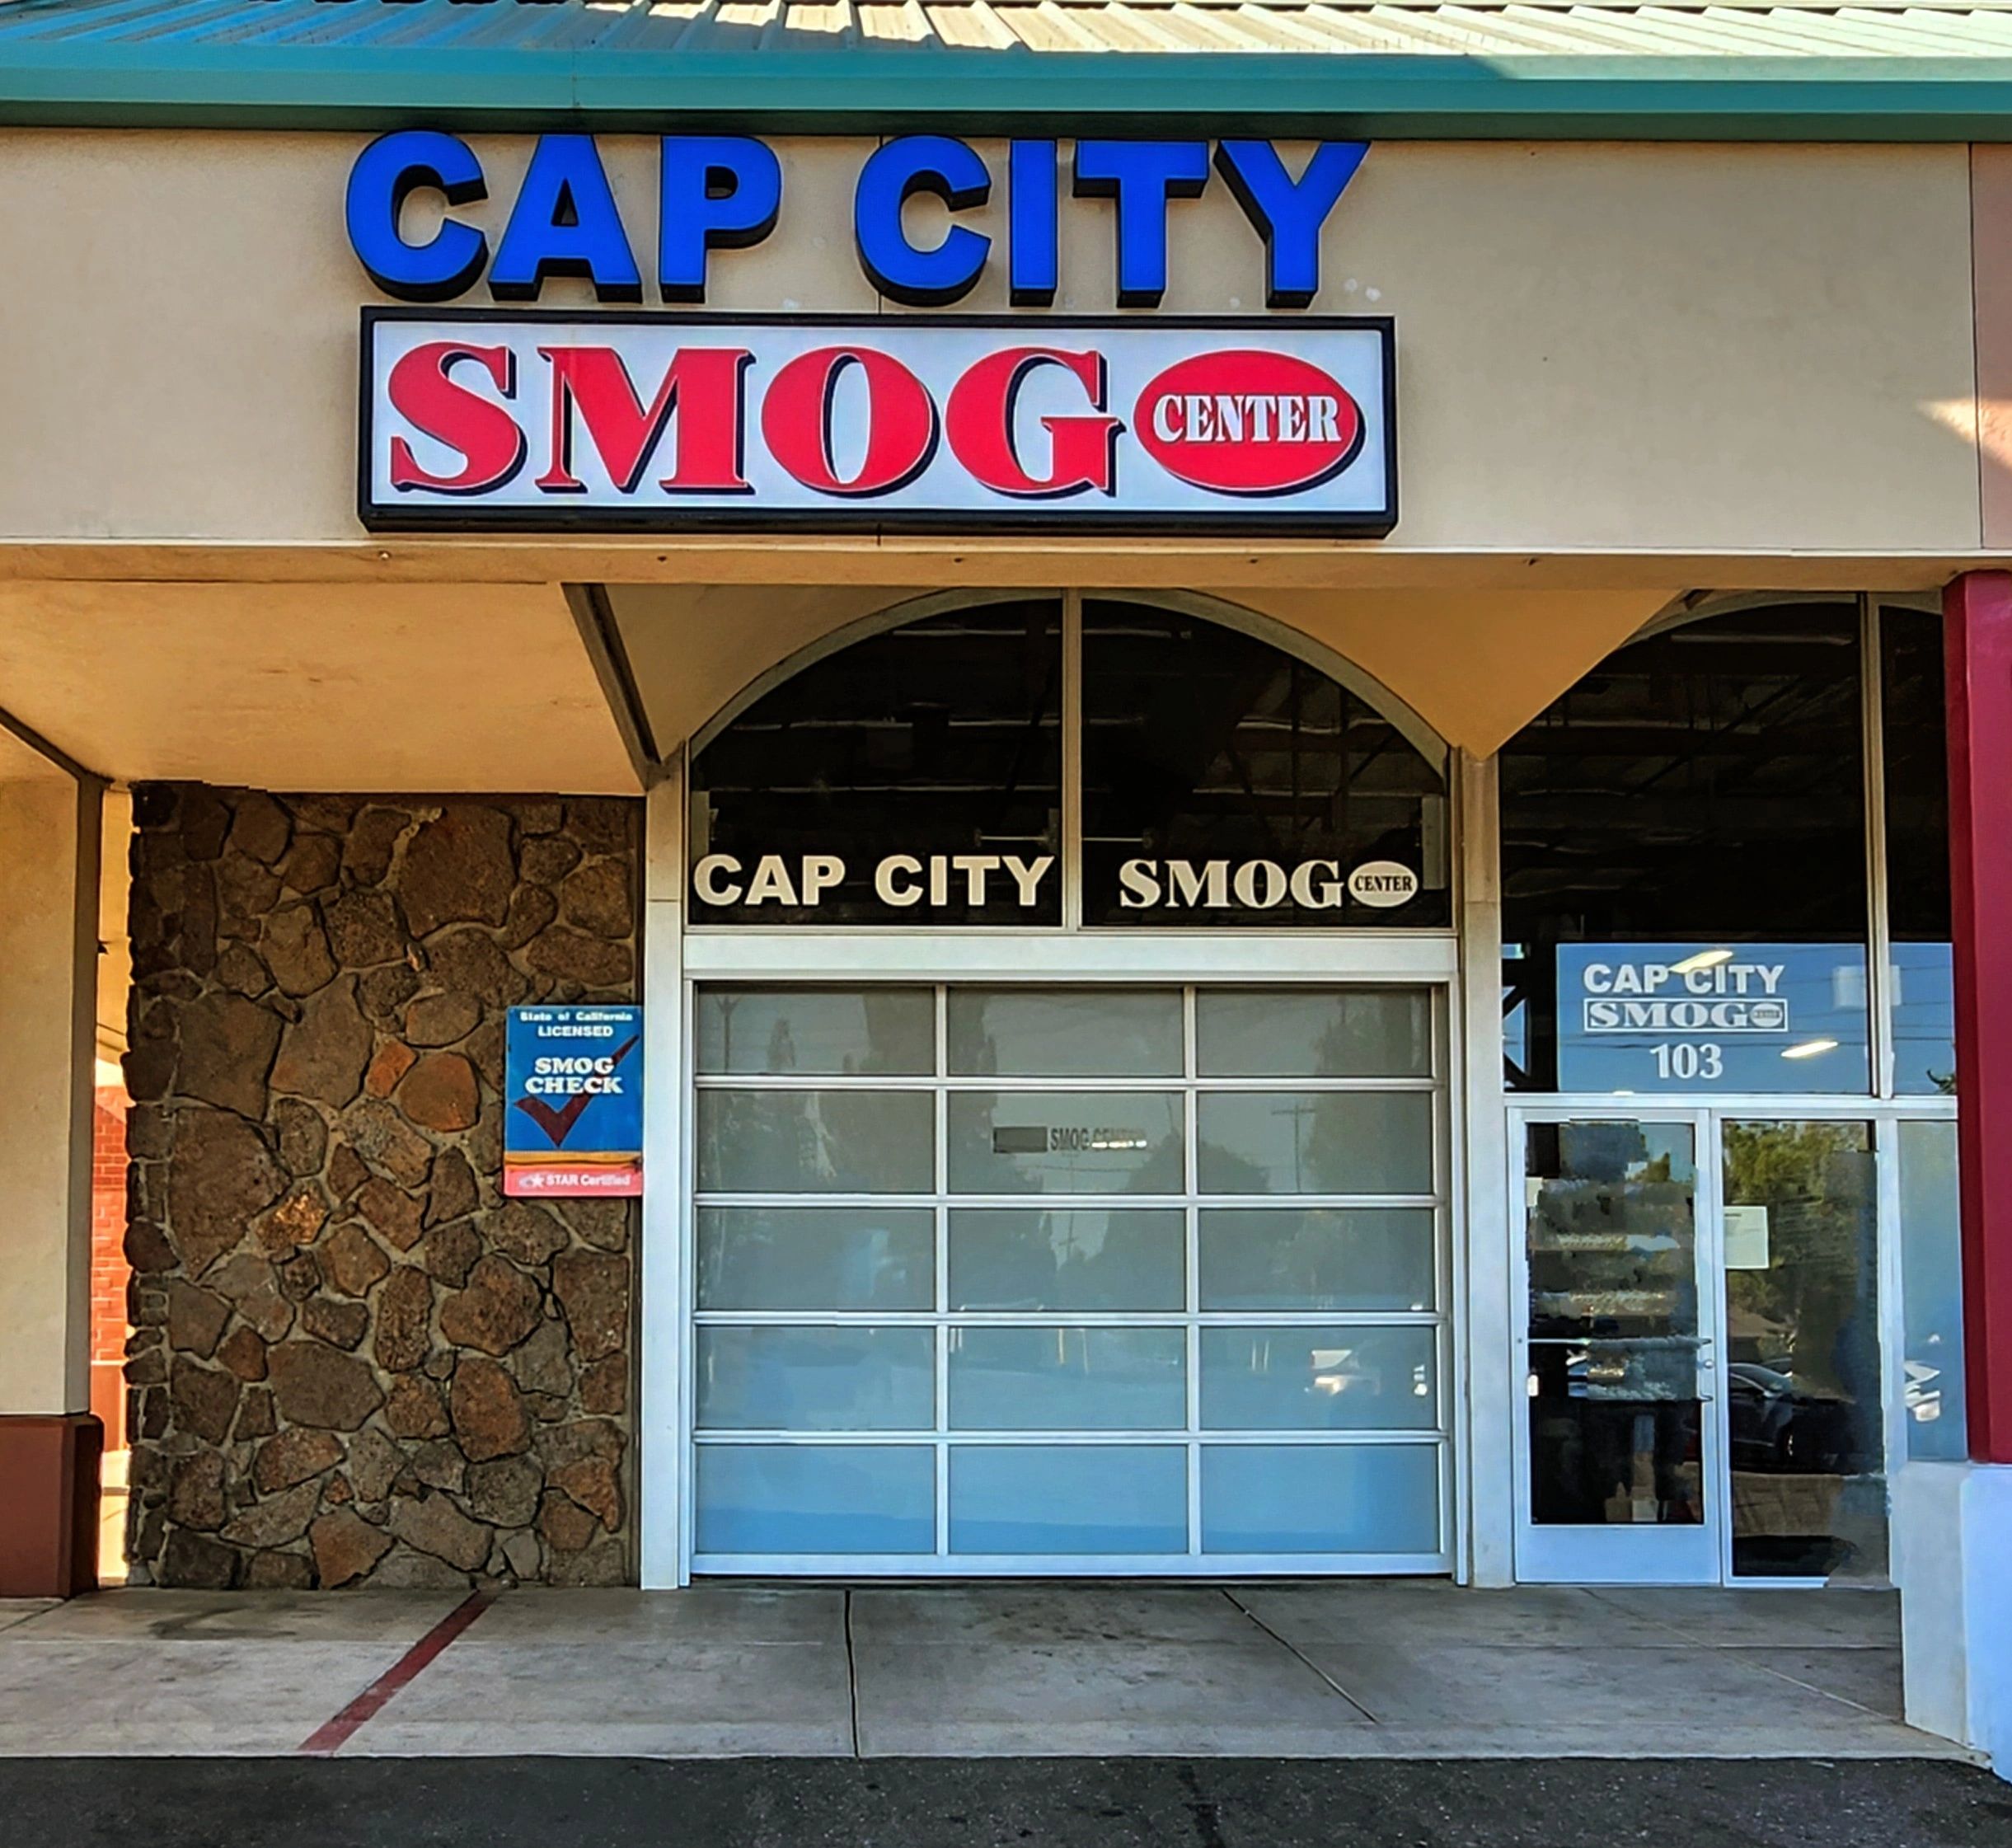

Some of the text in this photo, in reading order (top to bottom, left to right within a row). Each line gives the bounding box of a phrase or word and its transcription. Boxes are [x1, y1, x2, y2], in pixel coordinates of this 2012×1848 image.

[347, 130, 1371, 308] CAP CITY
[387, 341, 1343, 497] SMOG CENTER
[693, 854, 1054, 907] CAP CITY
[1119, 859, 1414, 908] SMOG CENTER
[1583, 964, 1785, 994] CAP CITY
[520, 1011, 633, 1021] State of California
[1589, 1002, 1748, 1028] SMOG
[537, 1025, 614, 1037] LICENSED
[534, 1057, 615, 1075] SMOG
[1650, 1043, 1724, 1079] 103
[524, 1076, 624, 1095] CHECK
[1050, 1127, 1090, 1151] SMOG
[546, 1175, 631, 1186] STAR Certified
